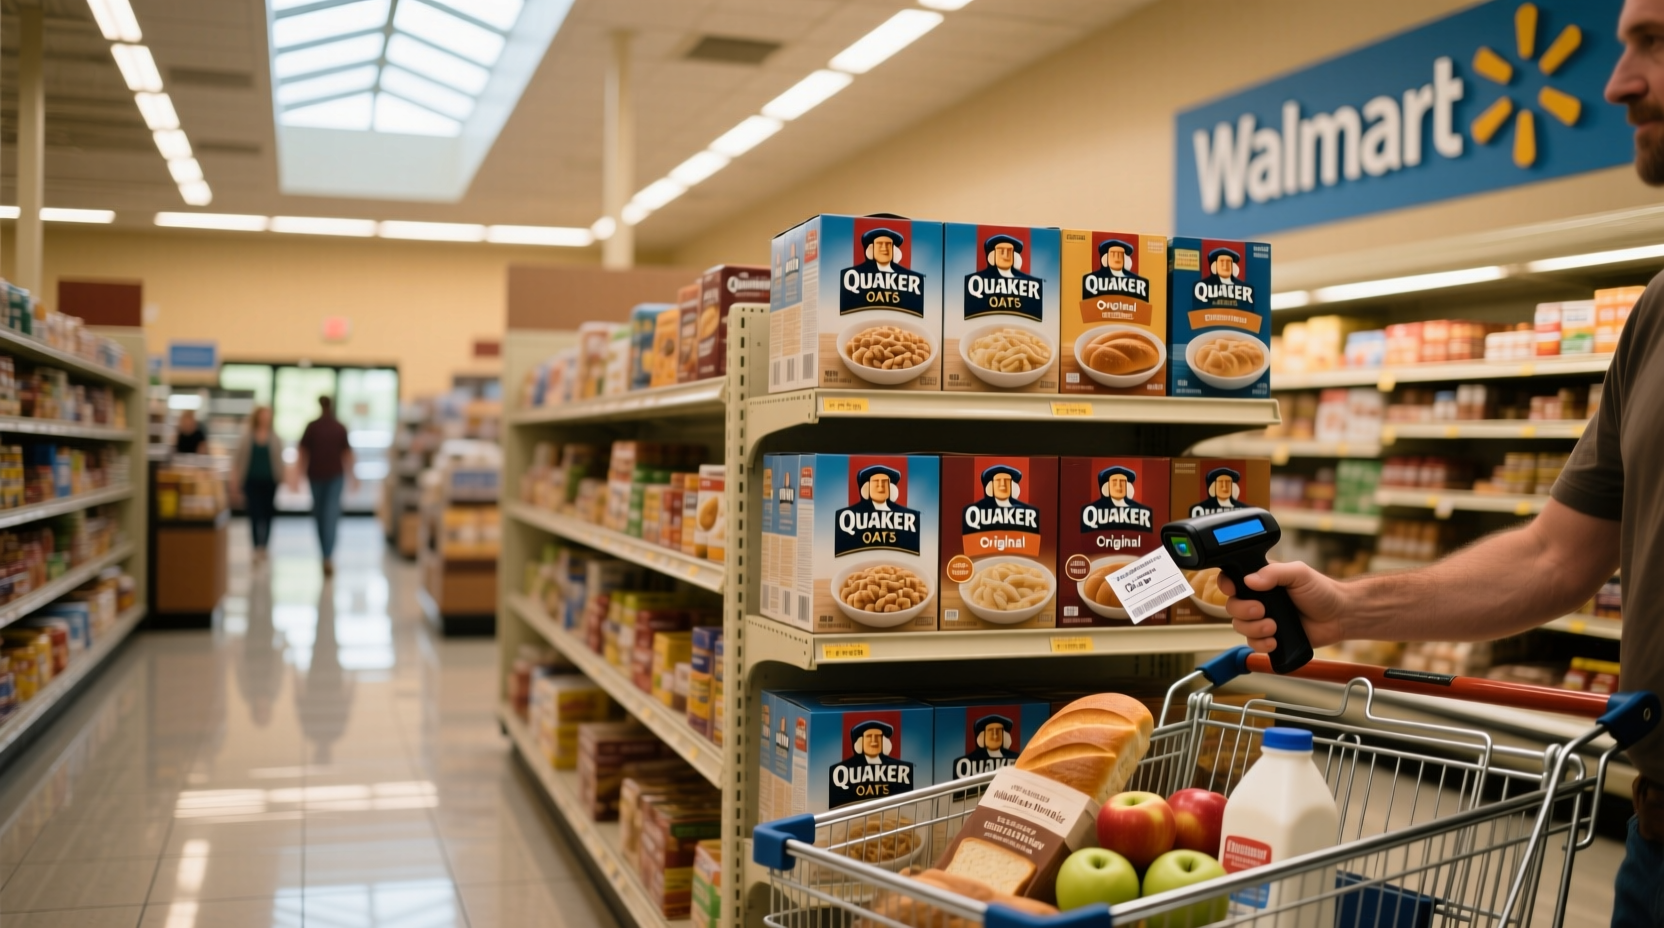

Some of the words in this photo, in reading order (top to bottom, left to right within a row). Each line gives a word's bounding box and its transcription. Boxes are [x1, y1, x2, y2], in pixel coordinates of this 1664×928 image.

[1193, 56, 1463, 214] Walmart
[844, 269, 921, 295] QUAKER
[968, 275, 1040, 299] QUAKER
[1085, 274, 1146, 297] QUAKER
[866, 291, 900, 303] OATS
[989, 296, 1022, 308] OATS
[839, 509, 916, 536] QUAKER
[965, 505, 1037, 529] QUAKER
[1082, 505, 1151, 529] QUAKER
[862, 531, 897, 544] OATS
[980, 534, 1026, 551] Original
[1096, 534, 1141, 551] Original
[832, 764, 910, 790] QUAKER
[856, 784, 889, 796] OATS
